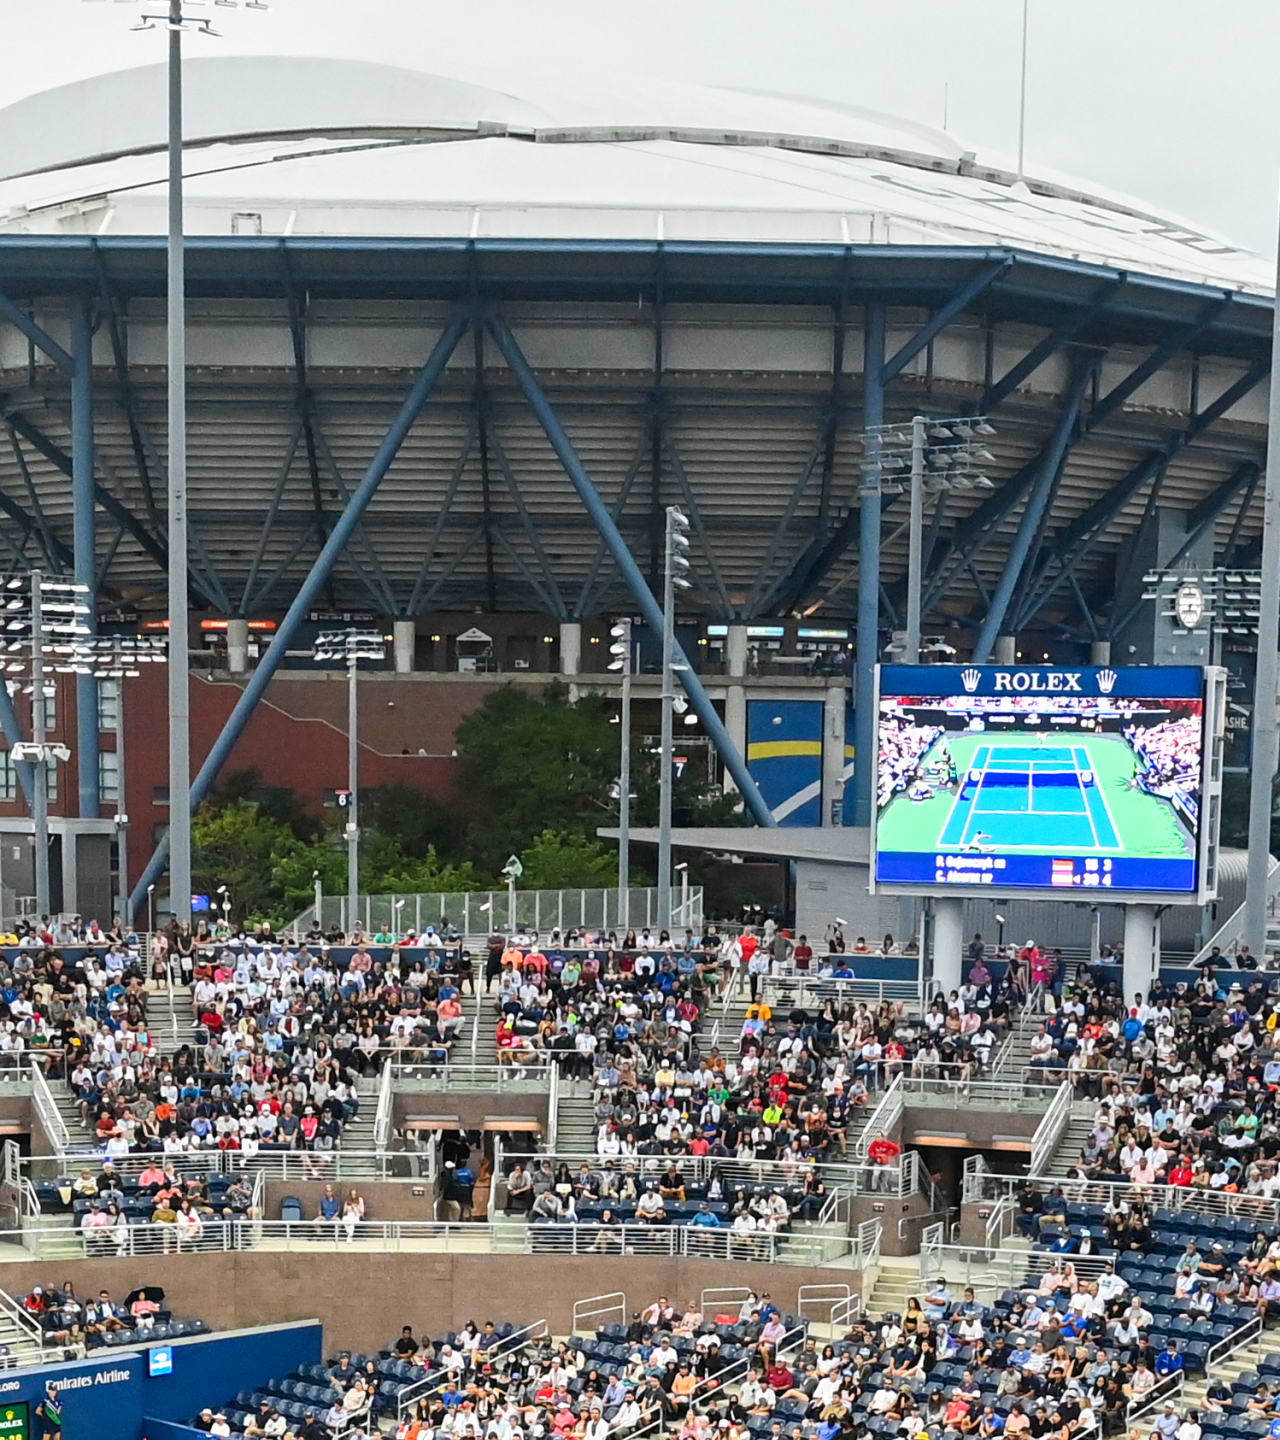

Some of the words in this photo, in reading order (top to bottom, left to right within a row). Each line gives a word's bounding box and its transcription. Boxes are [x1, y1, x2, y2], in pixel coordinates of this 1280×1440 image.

[993, 672, 1082, 691] ROLEX
[675, 762, 684, 778] 7
[338, 793, 347, 806] 6
[1102, 873, 1112, 886] 4
[94, 1369, 130, 1386] Airline
